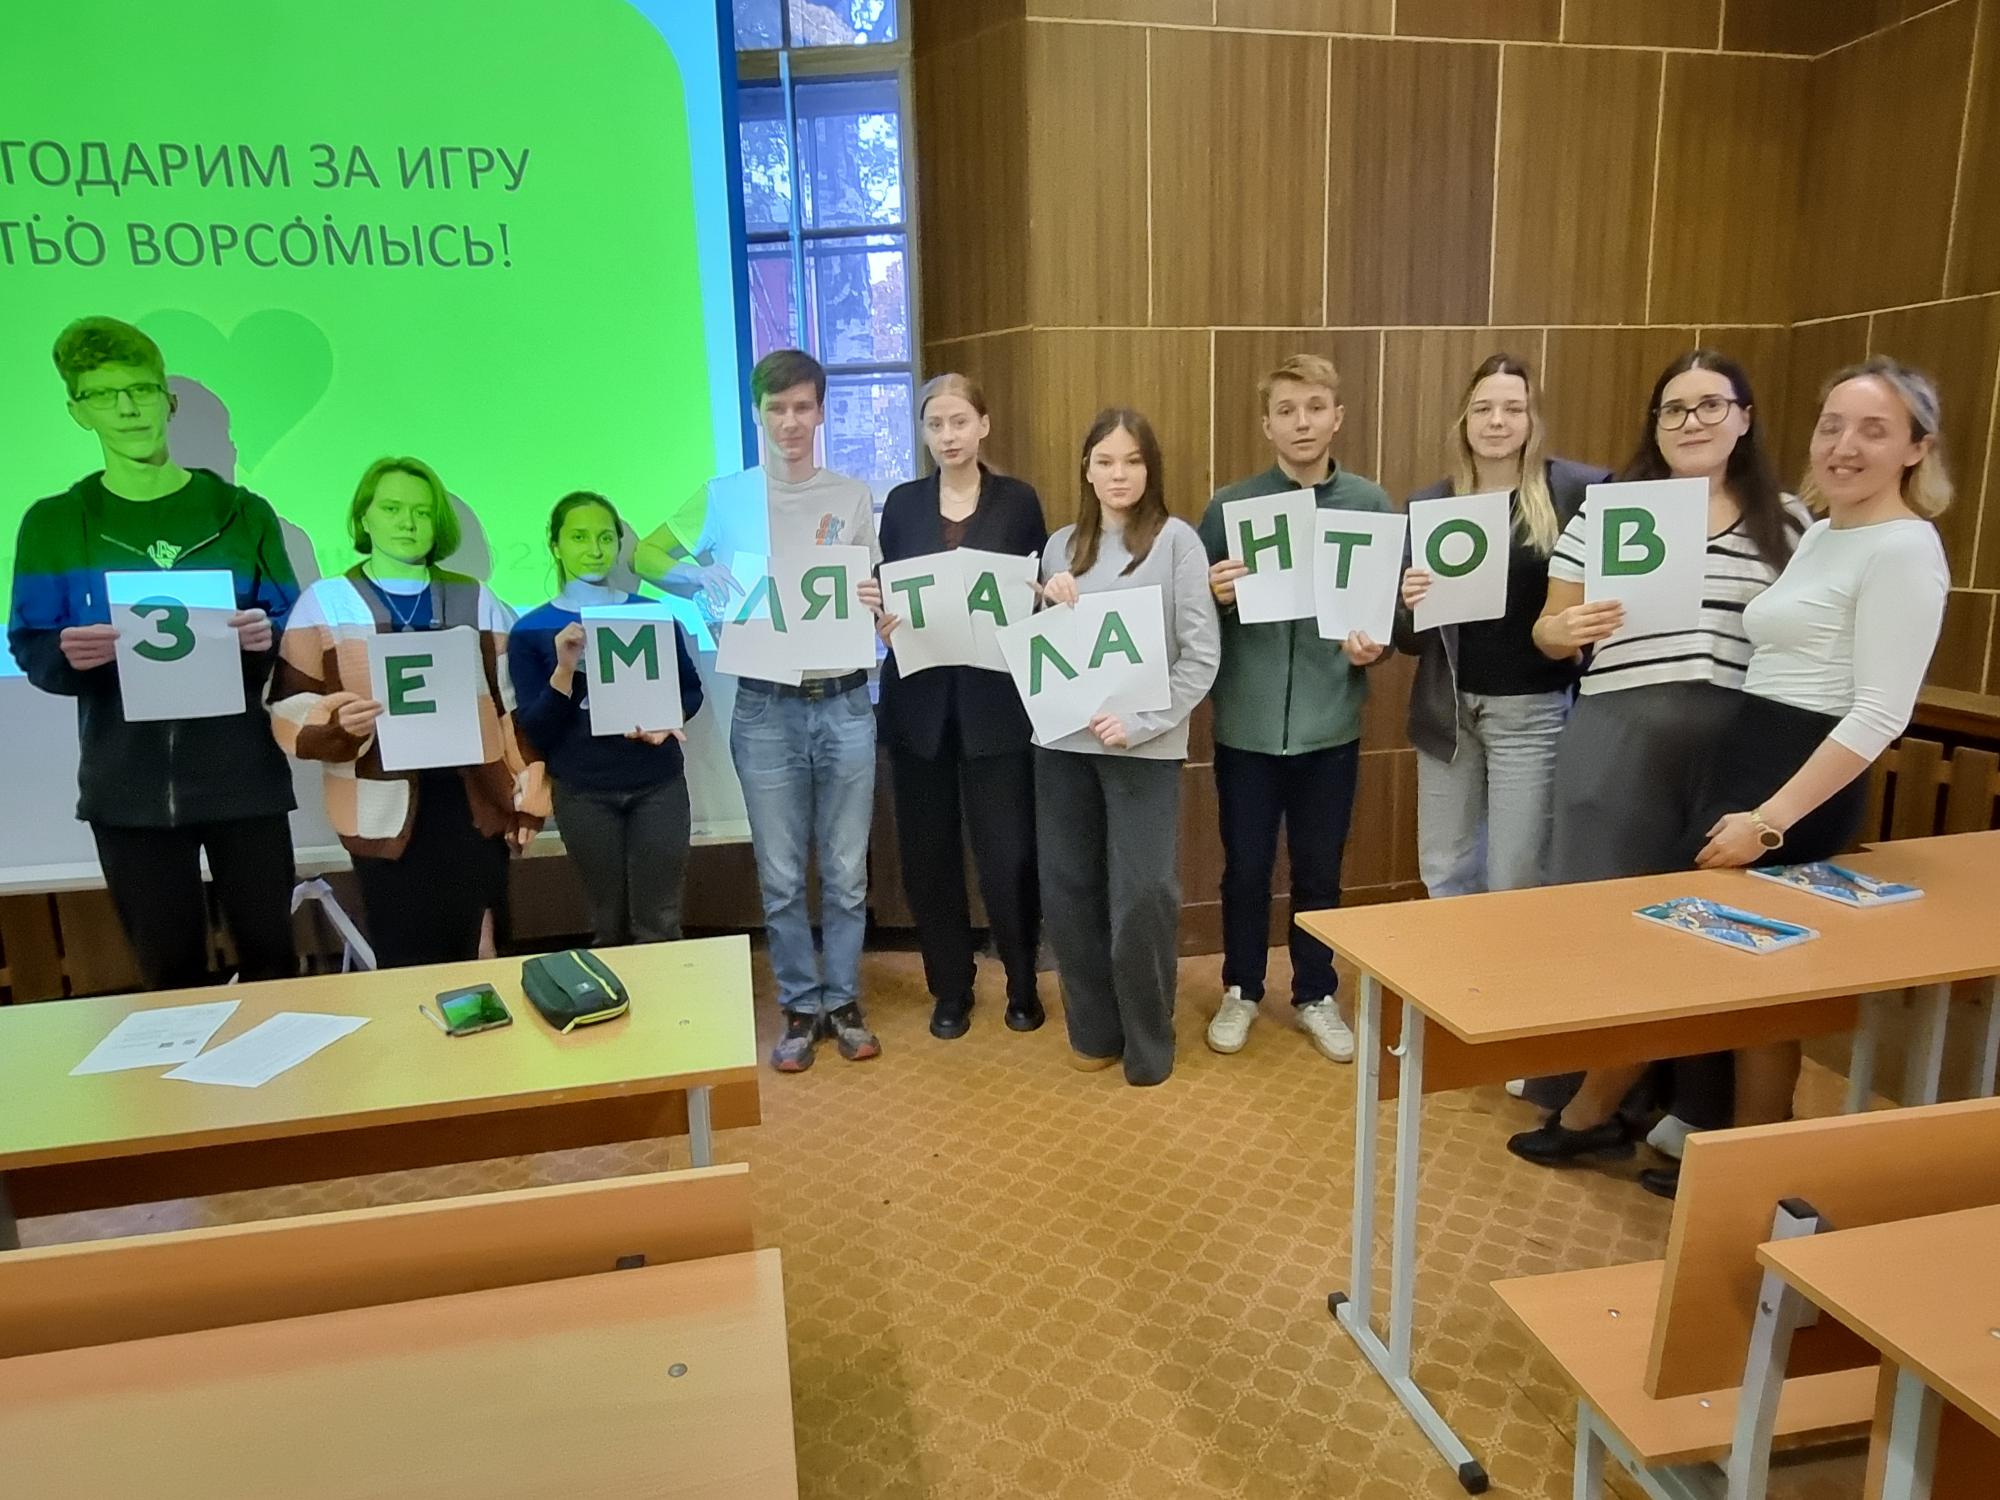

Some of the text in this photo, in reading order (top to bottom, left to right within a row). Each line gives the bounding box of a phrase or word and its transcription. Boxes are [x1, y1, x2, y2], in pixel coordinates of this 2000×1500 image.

[0, 140, 531, 198] ГОДАРИМ ЗА ИГРУ
[1239, 513, 1293, 574] Н
[1324, 531, 1373, 589] Т
[1425, 518, 1489, 578] О
[1602, 507, 1666, 577] В
[800, 565, 849, 620] Я
[891, 574, 935, 629] Т
[967, 571, 1009, 626] А
[596, 623, 661, 684] М
[1029, 634, 1080, 697] Л
[1087, 611, 1144, 669] А
[385, 654, 438, 717] Е
